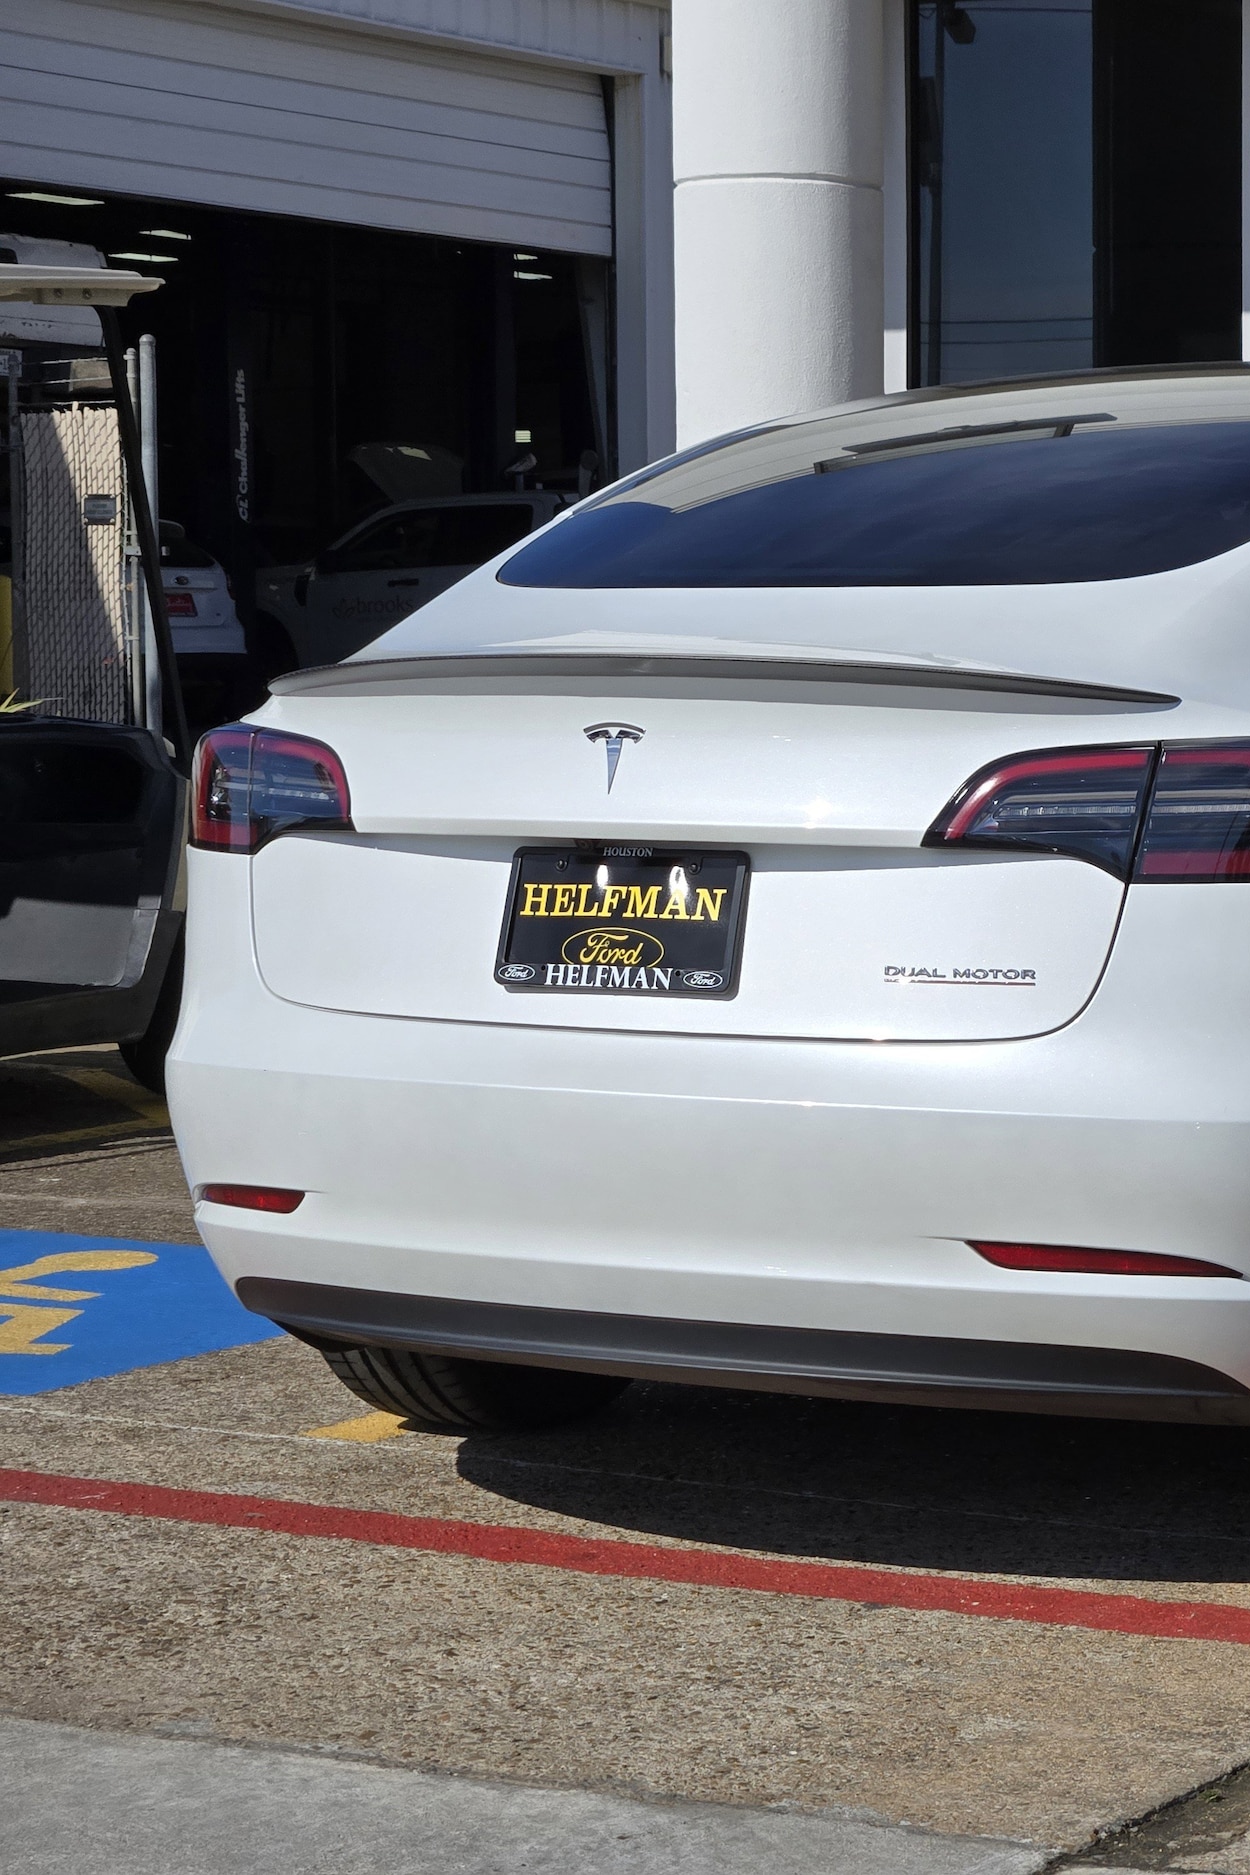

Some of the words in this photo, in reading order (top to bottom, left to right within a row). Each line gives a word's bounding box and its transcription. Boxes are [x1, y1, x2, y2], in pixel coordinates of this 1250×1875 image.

[235, 368, 246, 403] Lifts
[234, 404, 249, 494] Challenger
[603, 846, 653, 857] HOUSTON
[520, 883, 728, 921] HELFMAN
[580, 932, 644, 965] Ford
[505, 965, 528, 978] Ford
[544, 963, 673, 990] HELFMAN
[690, 973, 715, 985] Ford
[884, 965, 946, 978] DUAL
[953, 968, 1036, 980] MOTOR
